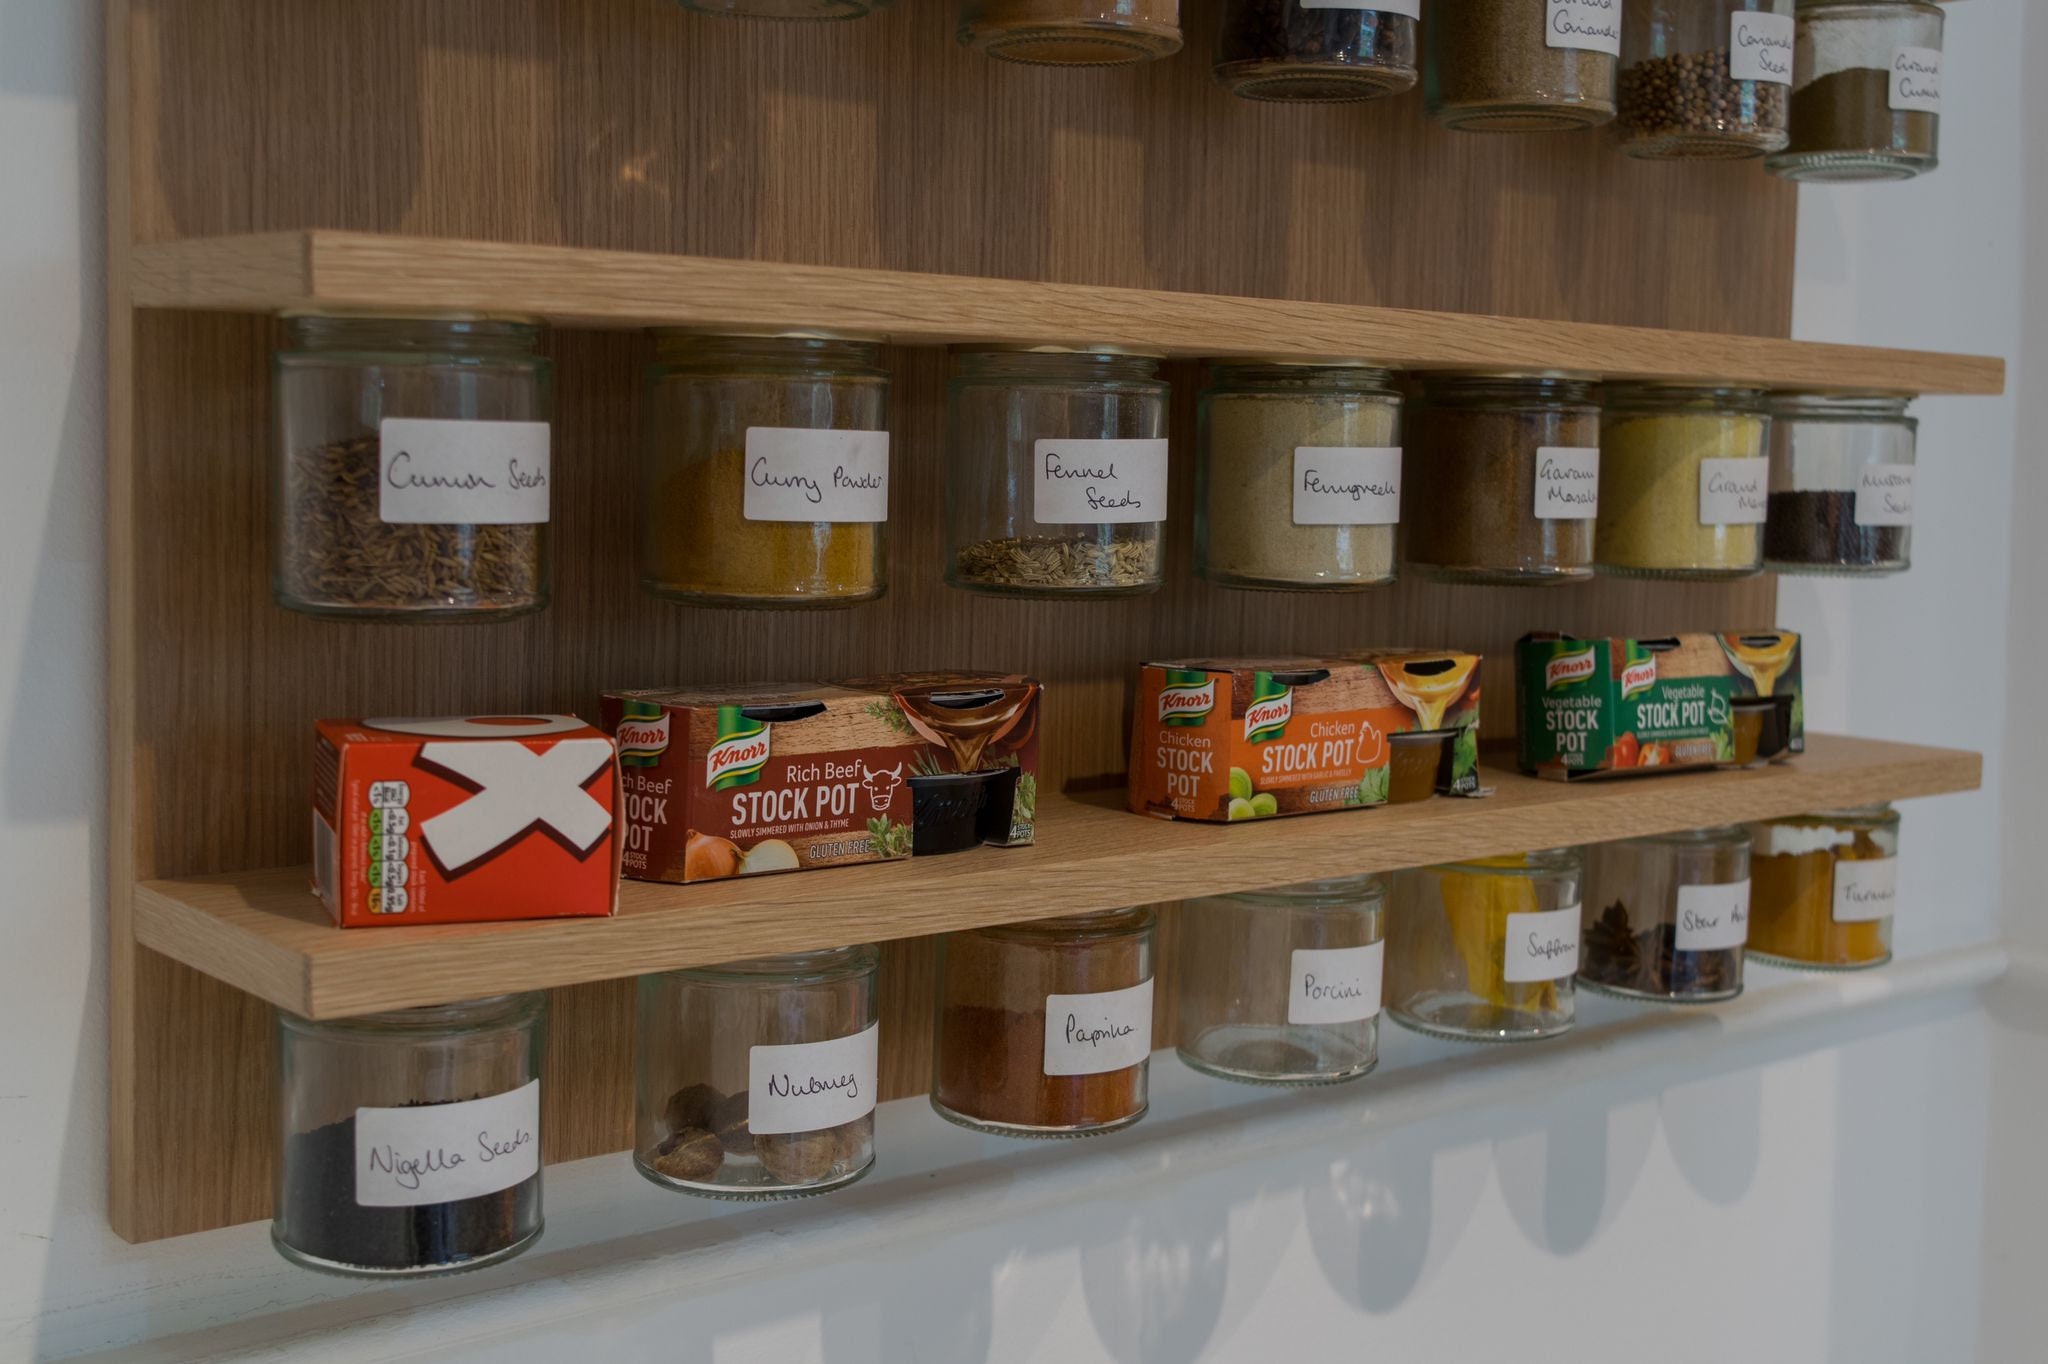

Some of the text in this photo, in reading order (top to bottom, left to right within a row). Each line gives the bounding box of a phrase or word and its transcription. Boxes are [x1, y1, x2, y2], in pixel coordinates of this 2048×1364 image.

[387, 451, 546, 490] Cumin Seeds
[1045, 453, 1118, 480] Fennel
[1540, 458, 1594, 480] Garam
[751, 456, 883, 503] Curry Powder
[1085, 486, 1141, 510] Seeds
[1550, 660, 1592, 679] Knorr
[1624, 668, 1654, 688] Knorr
[1161, 693, 1210, 710] Knorr
[1542, 695, 1602, 712] Vegetable
[1662, 684, 1705, 703] Vegetable
[1247, 703, 1289, 724] Knorr
[1546, 709, 1599, 731] STOCK
[1637, 701, 1705, 729] STOCK POT
[619, 725, 666, 748] Knorr
[1160, 730, 1211, 748] Chicken
[1310, 721, 1355, 738] Chicken
[1556, 731, 1588, 752] POT
[709, 740, 768, 772] Knorr
[1157, 747, 1213, 774] STOCK
[1262, 738, 1355, 774] STOCK POT
[787, 759, 862, 783] Rich Beef
[637, 775, 673, 794] Beef
[1168, 772, 1201, 797] POT
[1310, 786, 1359, 803] GLUTEN FREE
[731, 783, 859, 826] STOCK POT
[628, 823, 653, 852] OT
[730, 827, 754, 839] SLOWLY
[755, 824, 787, 837] SIMMERED
[788, 823, 804, 833] WITH
[805, 822, 823, 832] ONION
[830, 818, 849, 828] THYME
[809, 839, 871, 859] GLUTEN FREE
[1305, 973, 1362, 1000] Porcini
[1066, 1013, 1135, 1047] Paprika
[370, 1144, 465, 1189] Nigella
